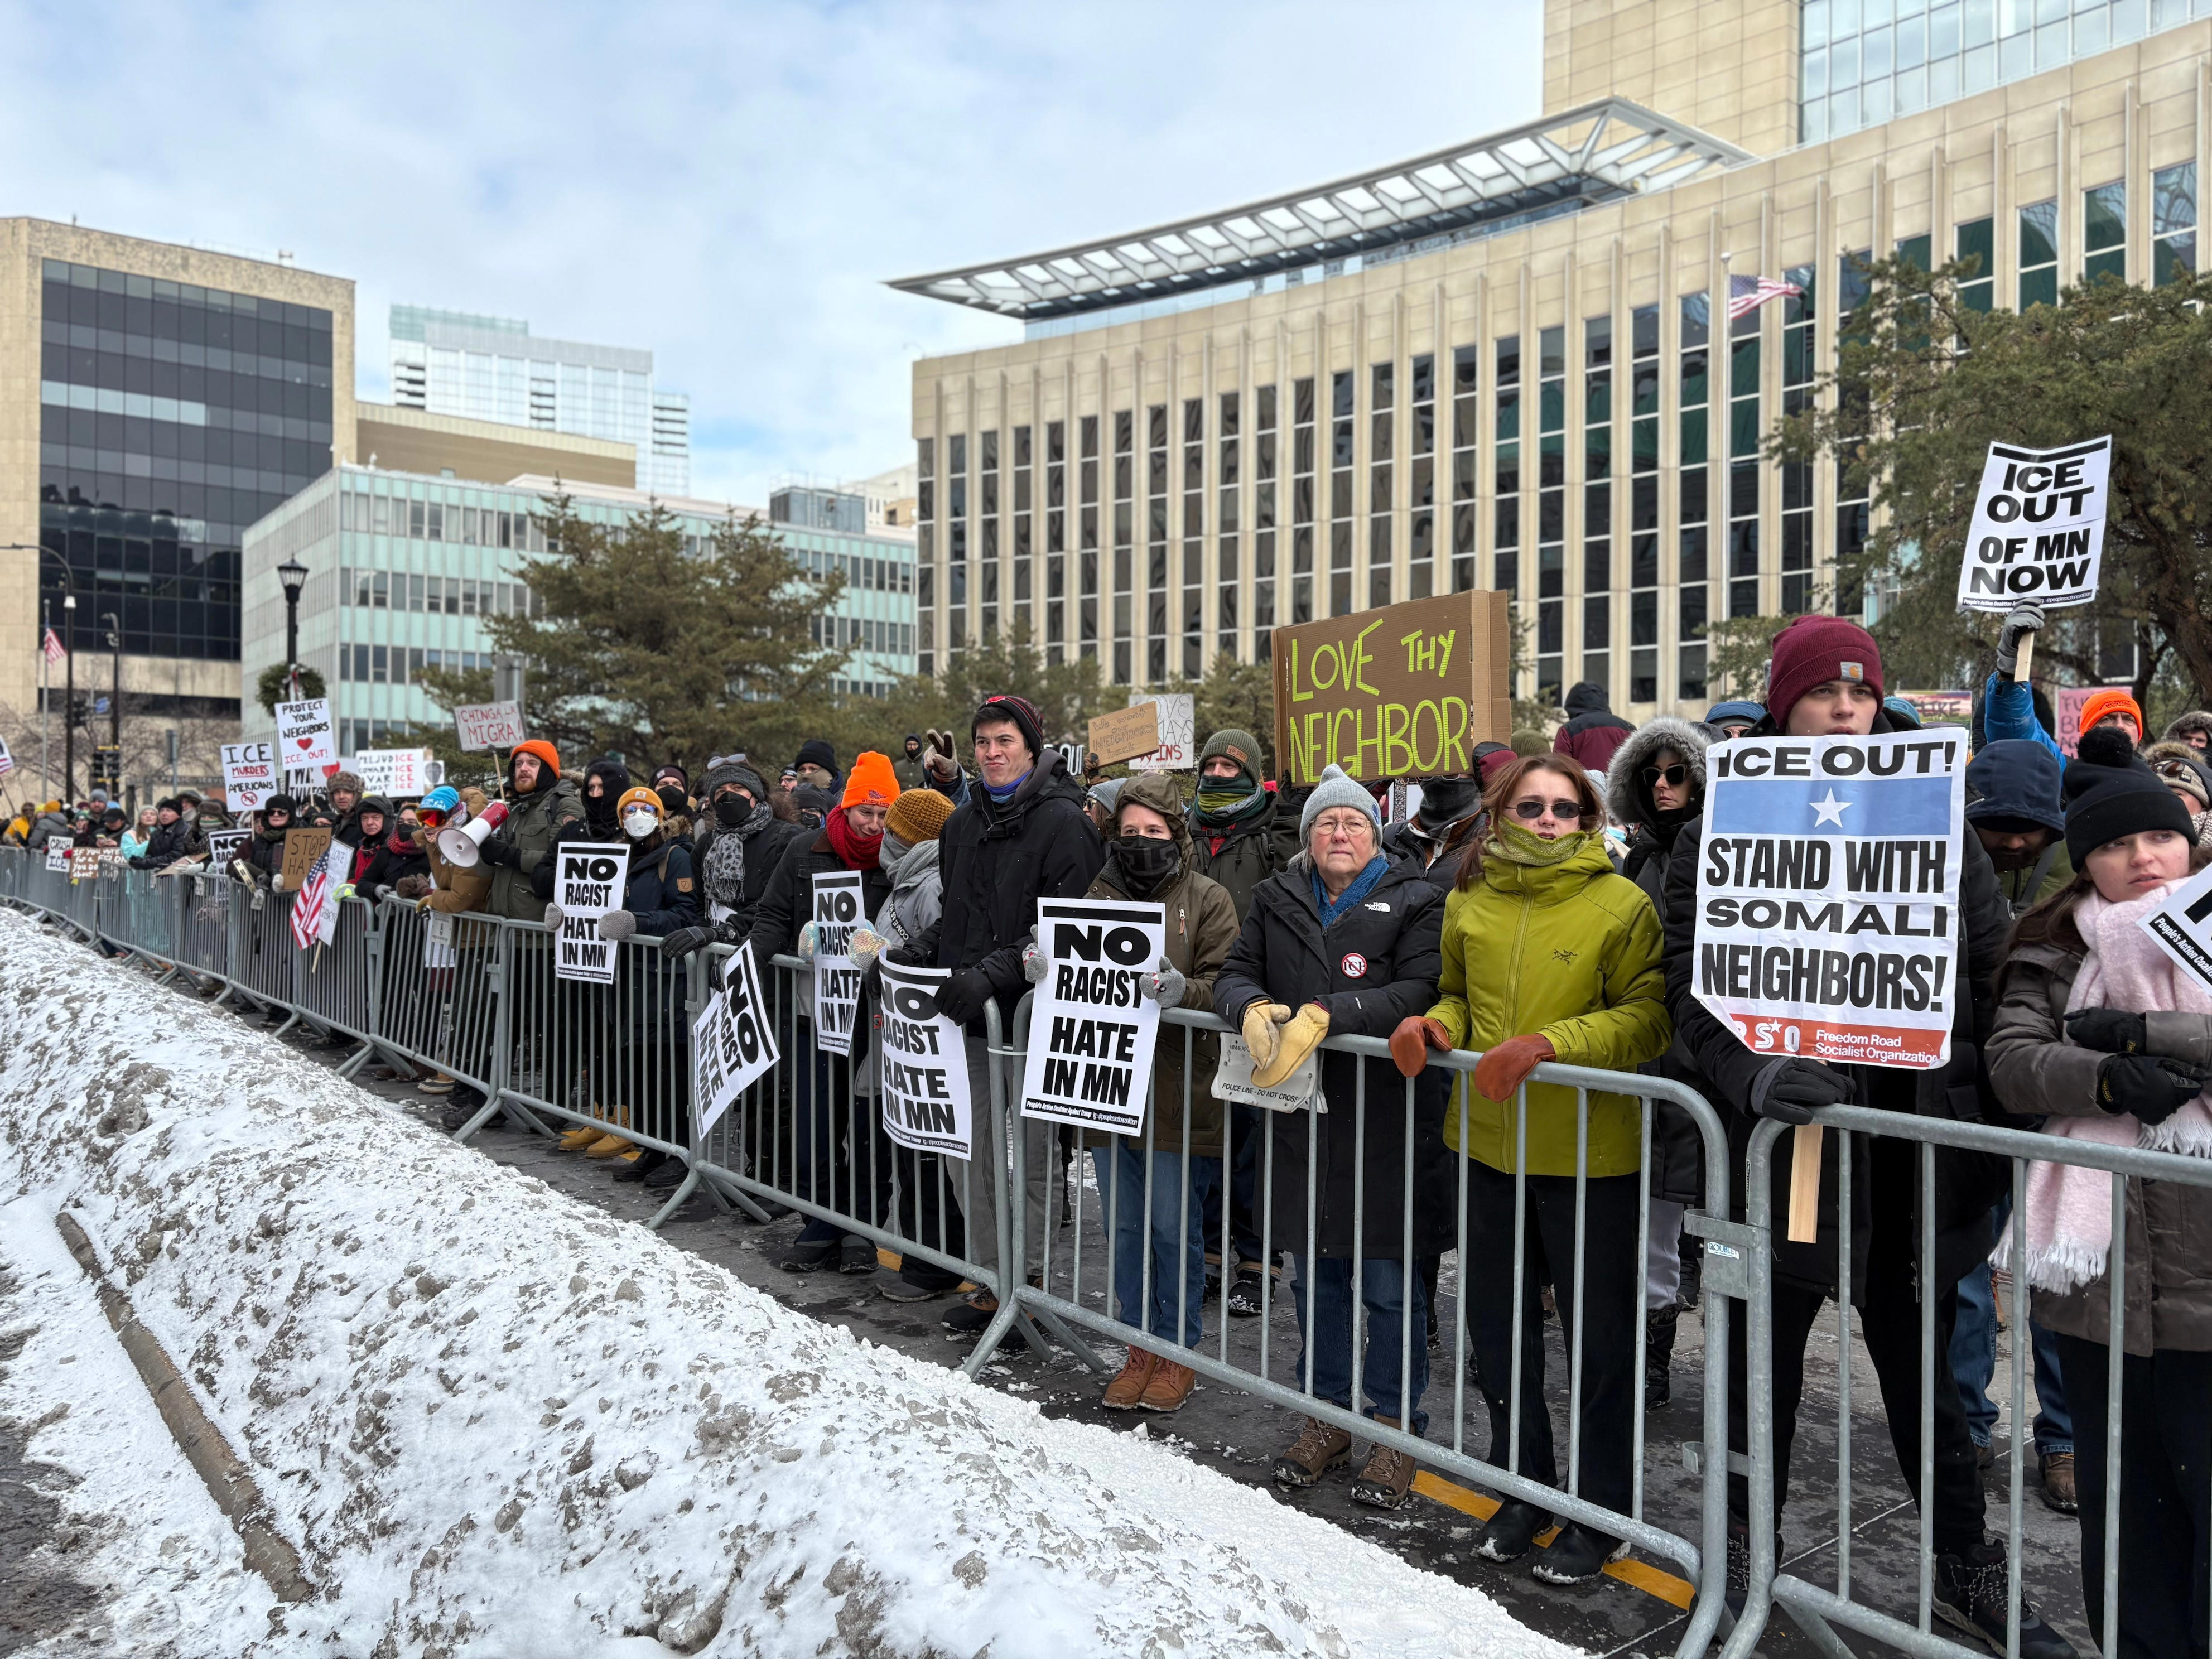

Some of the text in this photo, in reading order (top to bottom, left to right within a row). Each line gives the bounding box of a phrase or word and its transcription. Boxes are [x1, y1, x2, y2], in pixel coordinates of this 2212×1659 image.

[2003, 458, 2085, 493] ICE
[1987, 486, 2094, 523] OUT
[1979, 527, 2090, 564] OF MN
[1970, 558, 2091, 594] NOW
[1291, 618, 1456, 702] LOVE THY
[282, 701, 323, 715] PROTECT
[292, 712, 317, 723] YOUR
[505, 706, 517, 715] LA
[283, 722, 329, 739] NEIGHBORS
[1289, 696, 1469, 783] NEIGHBOR
[232, 765, 269, 776] MURDERS
[285, 748, 328, 764] ICE OUT!
[1718, 741, 1956, 777] ICE OUT!
[228, 781, 273, 793] AMERICANS
[50, 838, 71, 850] CRUSH
[214, 837, 244, 851] NO
[291, 835, 327, 857] STOP
[49, 856, 67, 869] ICE
[564, 857, 618, 881] NO
[1706, 838, 1946, 893] STAND WITH
[565, 883, 612, 908] RACIST
[817, 891, 857, 923] NO
[1706, 899, 1947, 937] SOMALI
[562, 942, 607, 968] IN MN
[1054, 923, 1151, 966] NO
[2155, 917, 2181, 943] People's
[2176, 939, 2198, 959] Action
[821, 968, 861, 1000] HATE
[1055, 964, 1144, 1009] RACIST
[1702, 943, 1948, 1012] NEIGHBORS!
[726, 963, 759, 1064] NO
[821, 1002, 836, 1032] IN
[881, 980, 941, 1021] NO
[699, 1021, 709, 1058] IN
[709, 1006, 724, 1099] HATE
[1050, 1016, 1139, 1062] HATE
[1816, 1030, 1901, 1046] Freedom Road
[1816, 1042, 1938, 1063] Socialist Organization
[699, 1062, 712, 1116] MN
[884, 1052, 950, 1099] HATE
[1042, 1058, 1132, 1107] IN MN
[885, 1085, 902, 1126] IN
[904, 1098, 956, 1135] MN
[1027, 1101, 1042, 1109] People's
[1042, 1102, 1053, 1111] Action
[1053, 1105, 1068, 1113] Coalition
[1068, 1107, 1081, 1116] Against
[1279, 1093, 1299, 1102] CROSS
